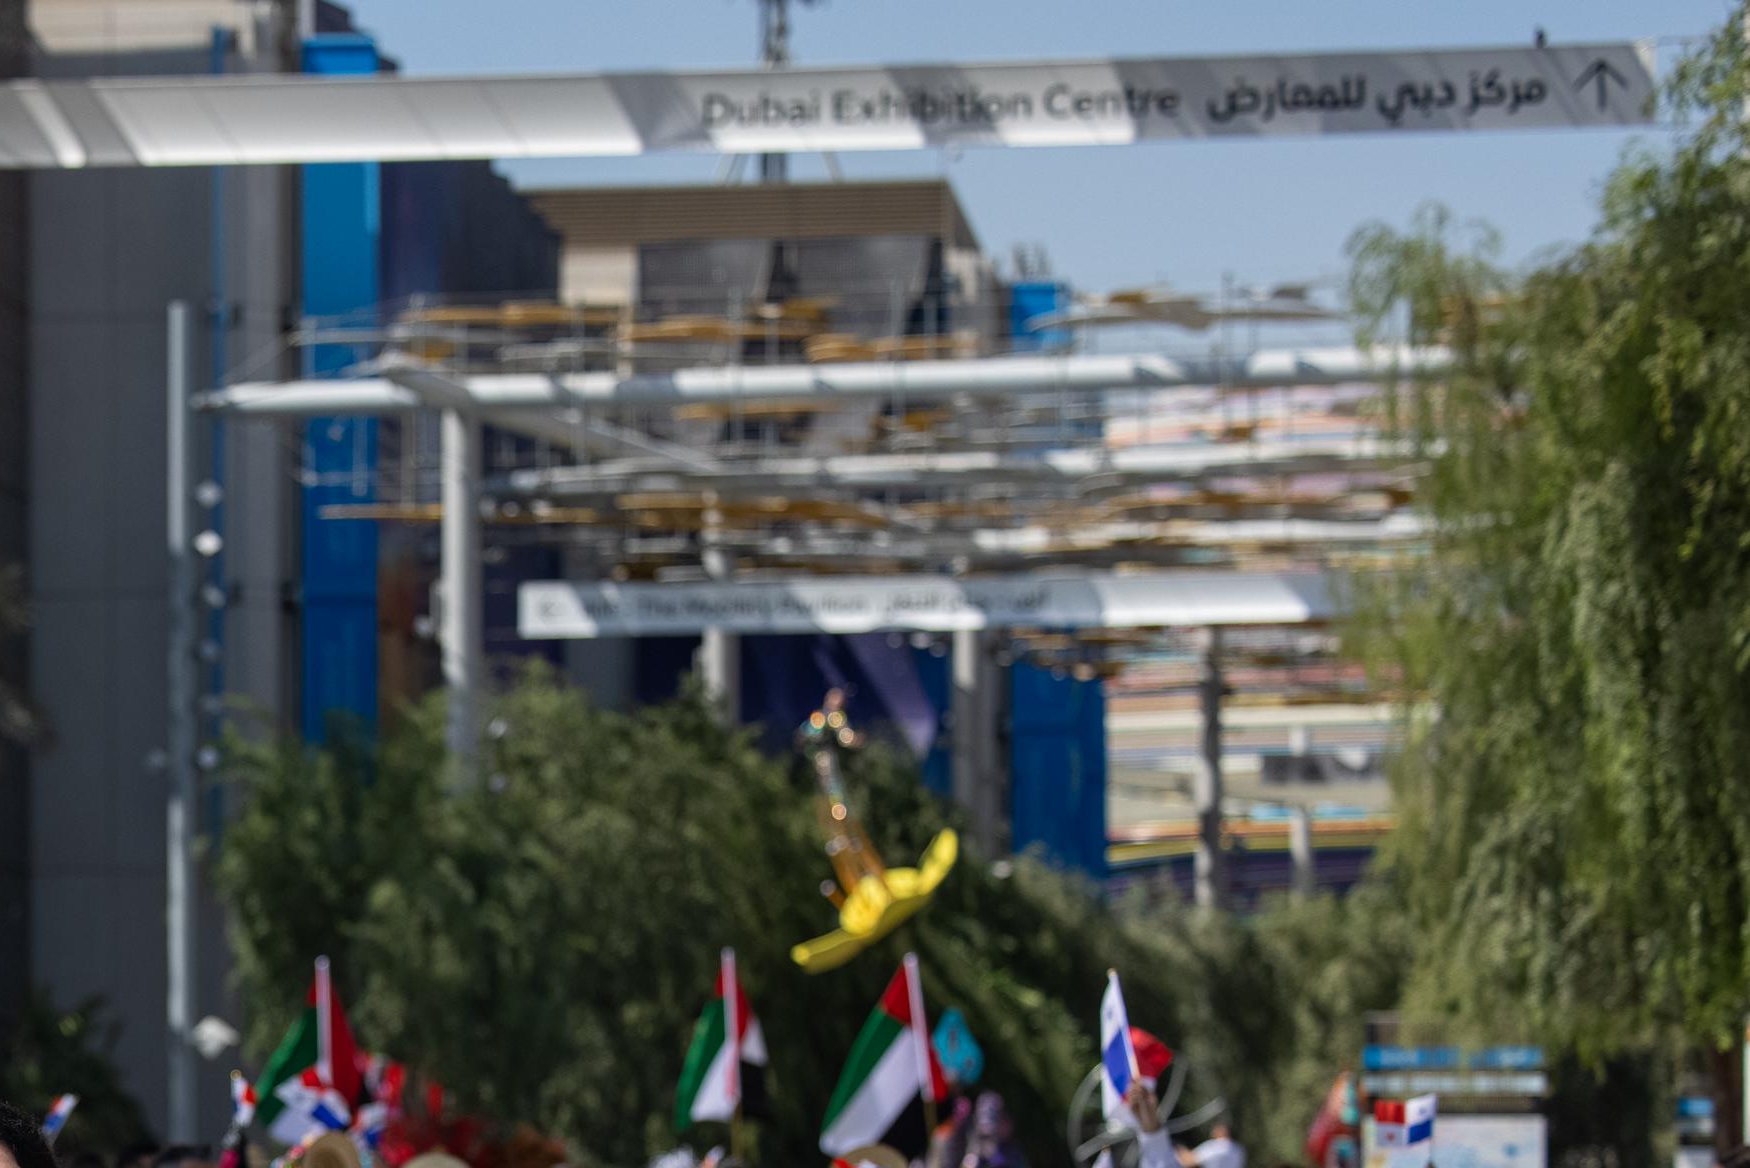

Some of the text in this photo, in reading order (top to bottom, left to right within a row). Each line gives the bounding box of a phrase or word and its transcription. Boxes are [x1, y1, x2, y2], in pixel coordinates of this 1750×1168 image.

[701, 77, 1180, 128] Dubai Exhibition Centre
[1206, 66, 1549, 127] مركز دبي للمعارض
